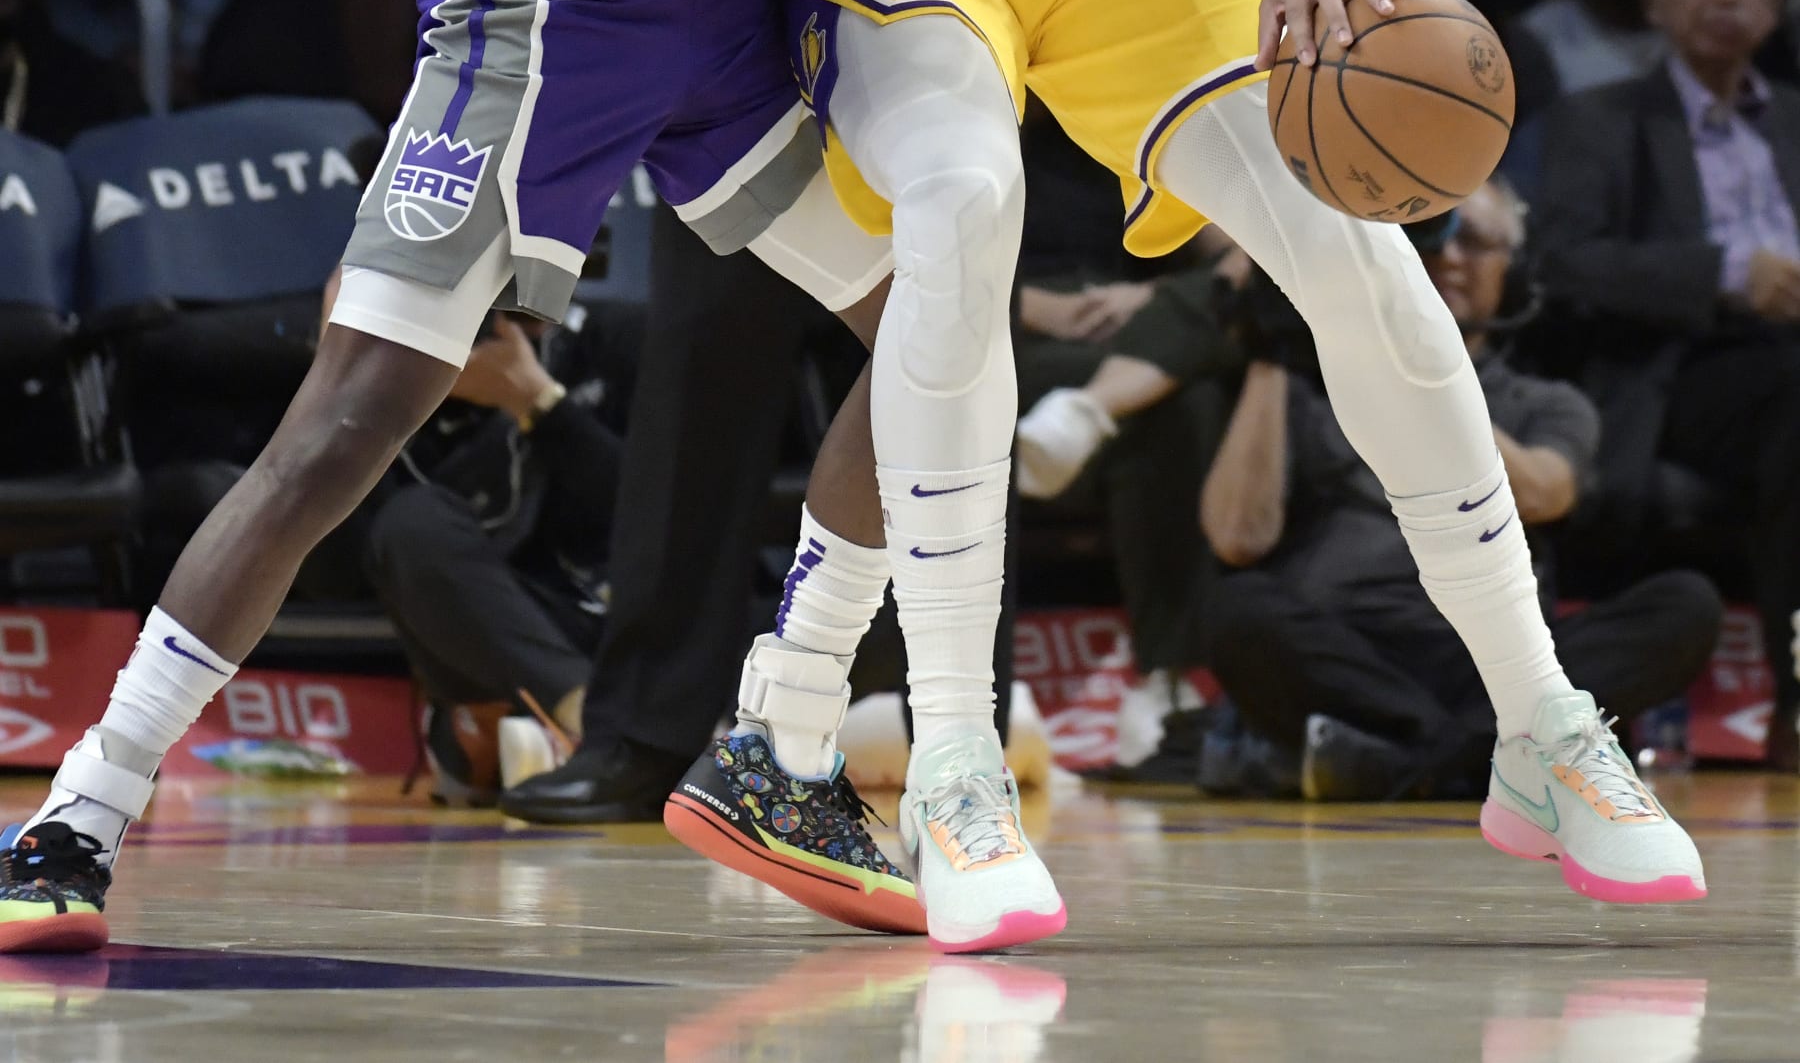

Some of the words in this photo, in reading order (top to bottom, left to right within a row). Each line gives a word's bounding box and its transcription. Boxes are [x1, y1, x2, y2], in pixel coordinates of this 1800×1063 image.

[149, 147, 360, 209] DELTA
[391, 168, 474, 207] SAC
[224, 681, 351, 738] BIO
[684, 783, 731, 816] CONVERSE
